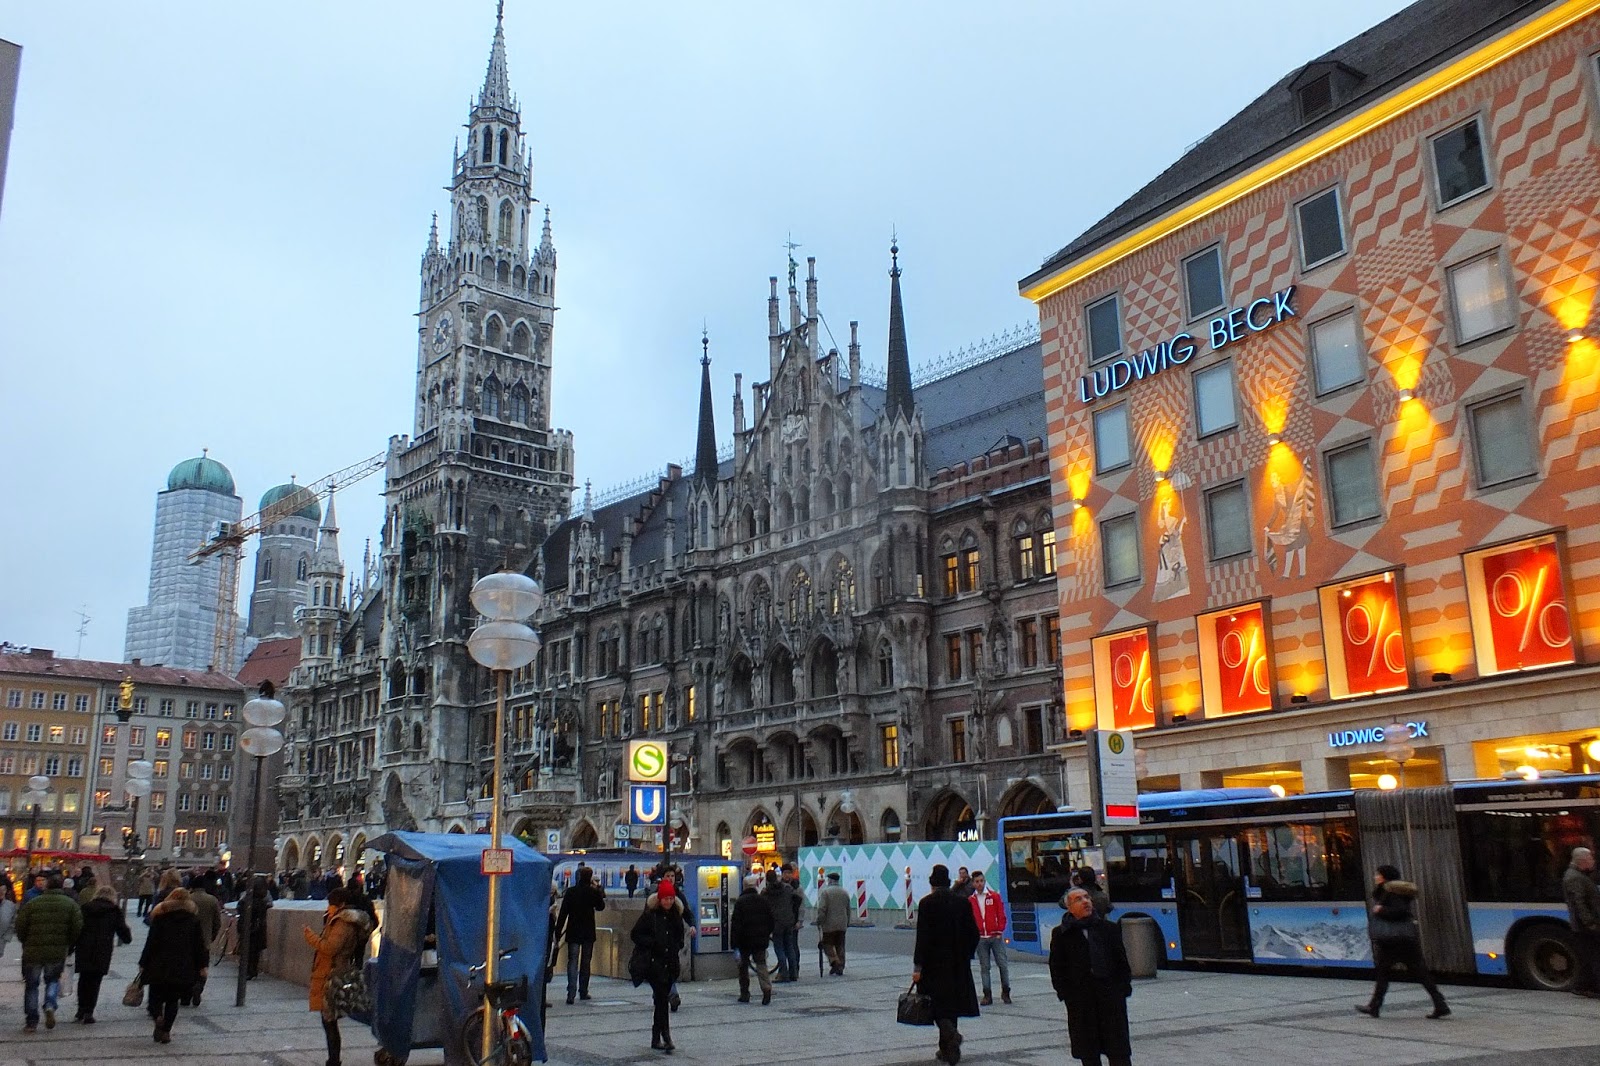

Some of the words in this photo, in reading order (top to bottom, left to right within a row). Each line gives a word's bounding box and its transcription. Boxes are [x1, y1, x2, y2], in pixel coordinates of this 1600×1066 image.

[1080, 333, 1195, 404] LUDWIG
[1209, 286, 1296, 350] BECK
[1328, 727, 1385, 748] LUDWIG
[637, 745, 660, 777] S
[635, 789, 660, 823] U
